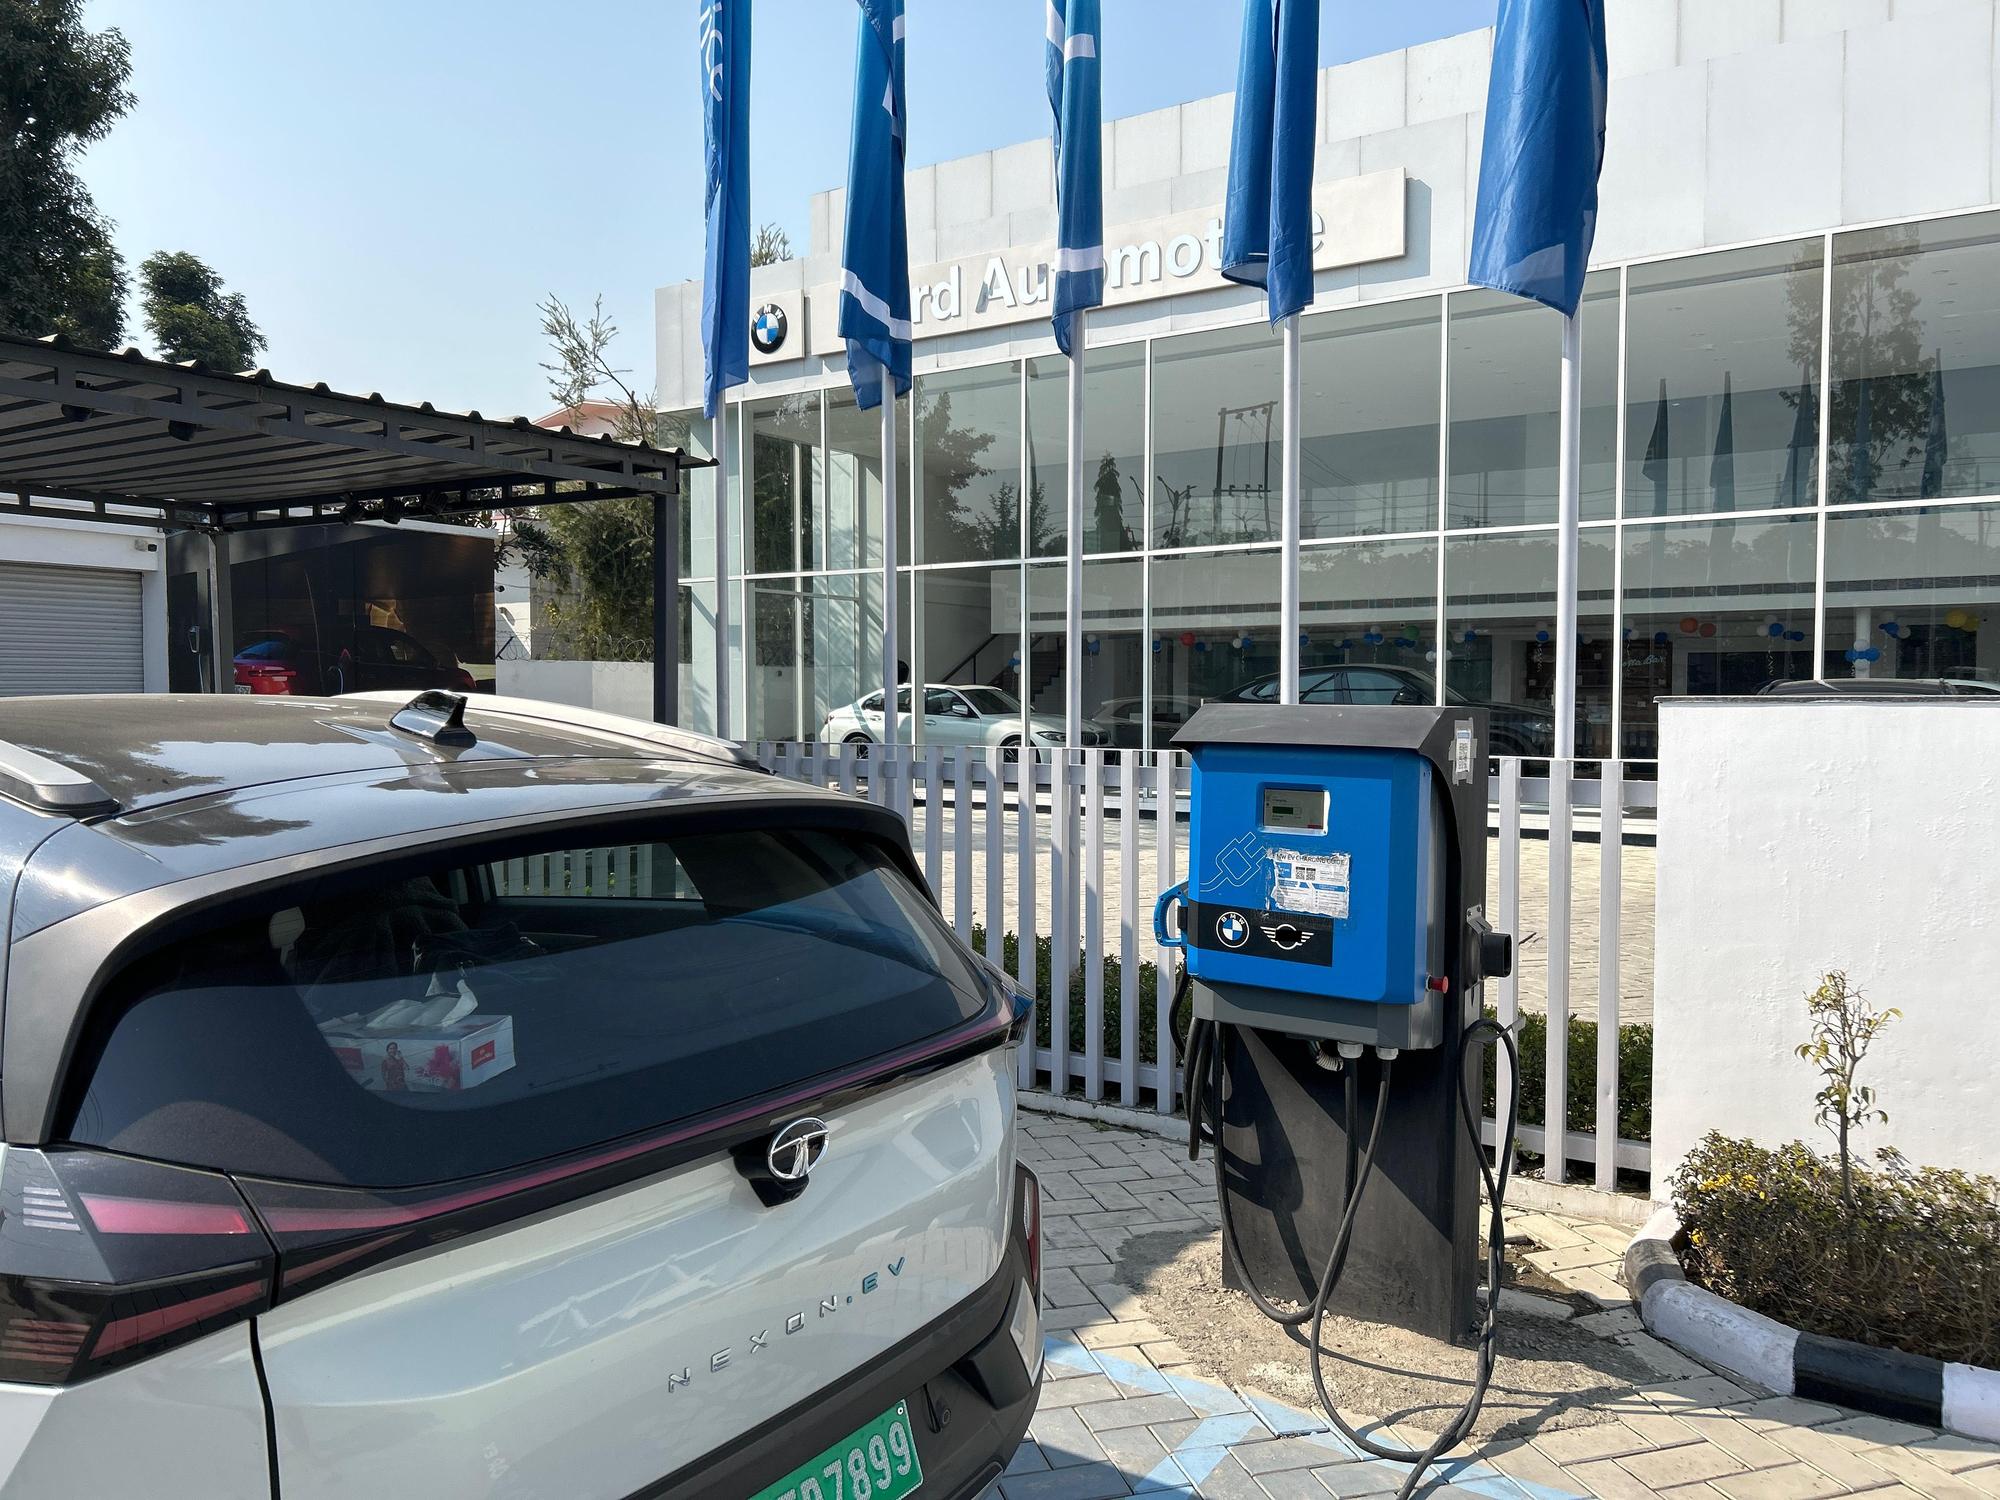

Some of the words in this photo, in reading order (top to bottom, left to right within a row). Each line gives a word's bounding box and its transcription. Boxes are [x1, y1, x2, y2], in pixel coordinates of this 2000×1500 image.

[975, 208, 1326, 315] Aumot
[1288, 853, 1295, 861] EV
[777, 1421, 912, 1500] 7899
